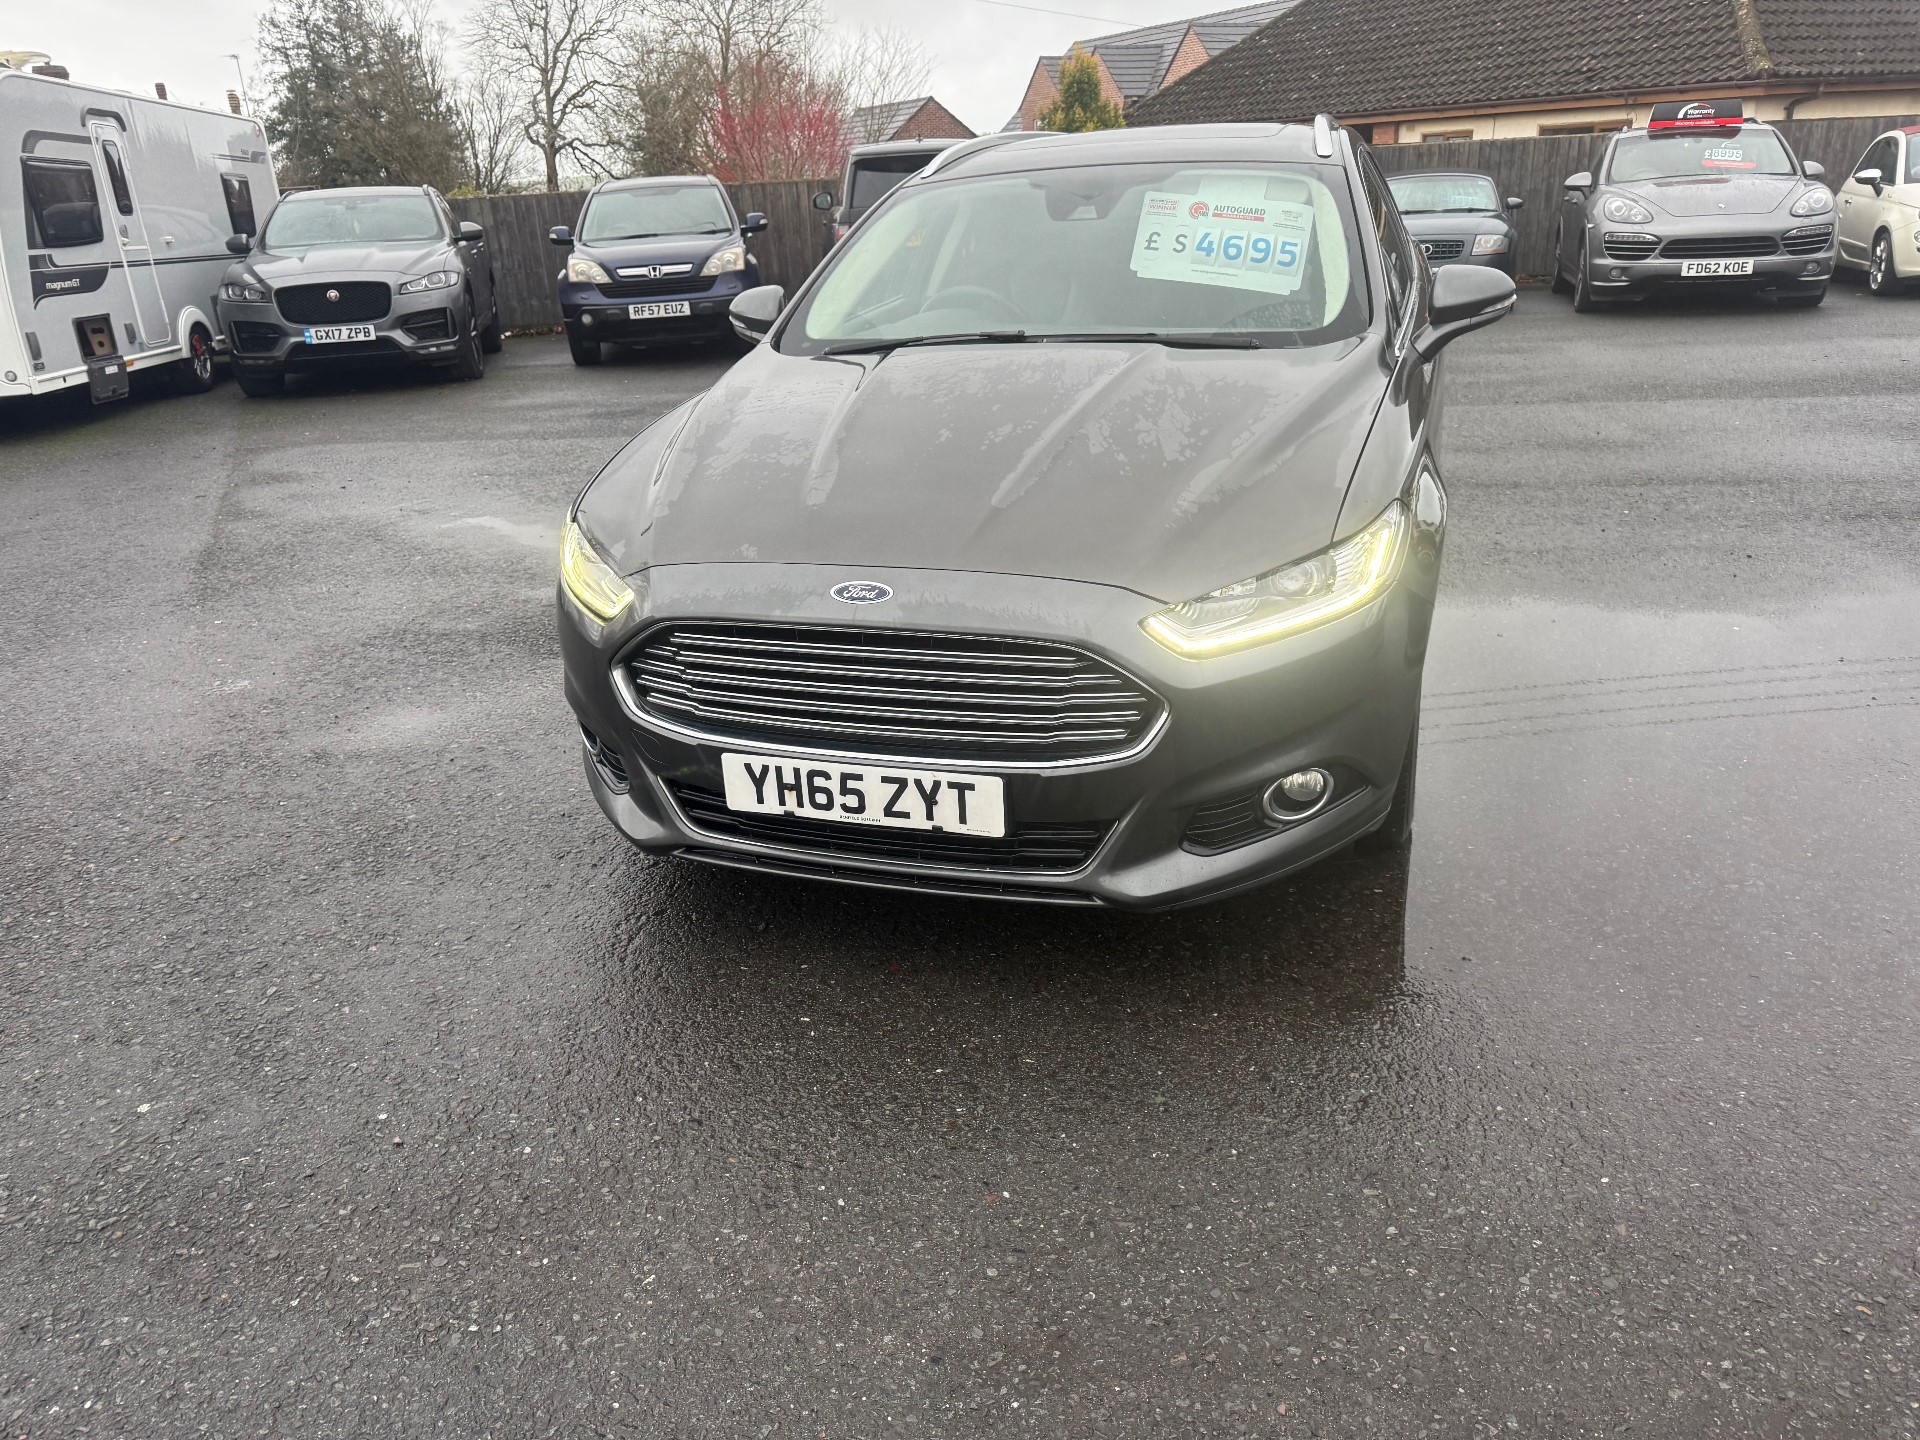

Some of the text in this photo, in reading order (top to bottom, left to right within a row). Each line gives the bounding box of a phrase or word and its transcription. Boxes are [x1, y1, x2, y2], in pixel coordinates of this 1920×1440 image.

[1687, 108, 1716, 116] Warranty
[1149, 203, 1177, 211] WINNER
[1213, 204, 1266, 216] AUTOGUARD
[1195, 232, 1299, 268] 4695
[1687, 261, 1749, 274] FD62 KOE
[633, 303, 685, 317] RF57 EUZ
[314, 326, 371, 341] GX17 ZPB
[842, 585, 879, 599] Ford
[743, 762, 976, 825] YH65 ZYT
